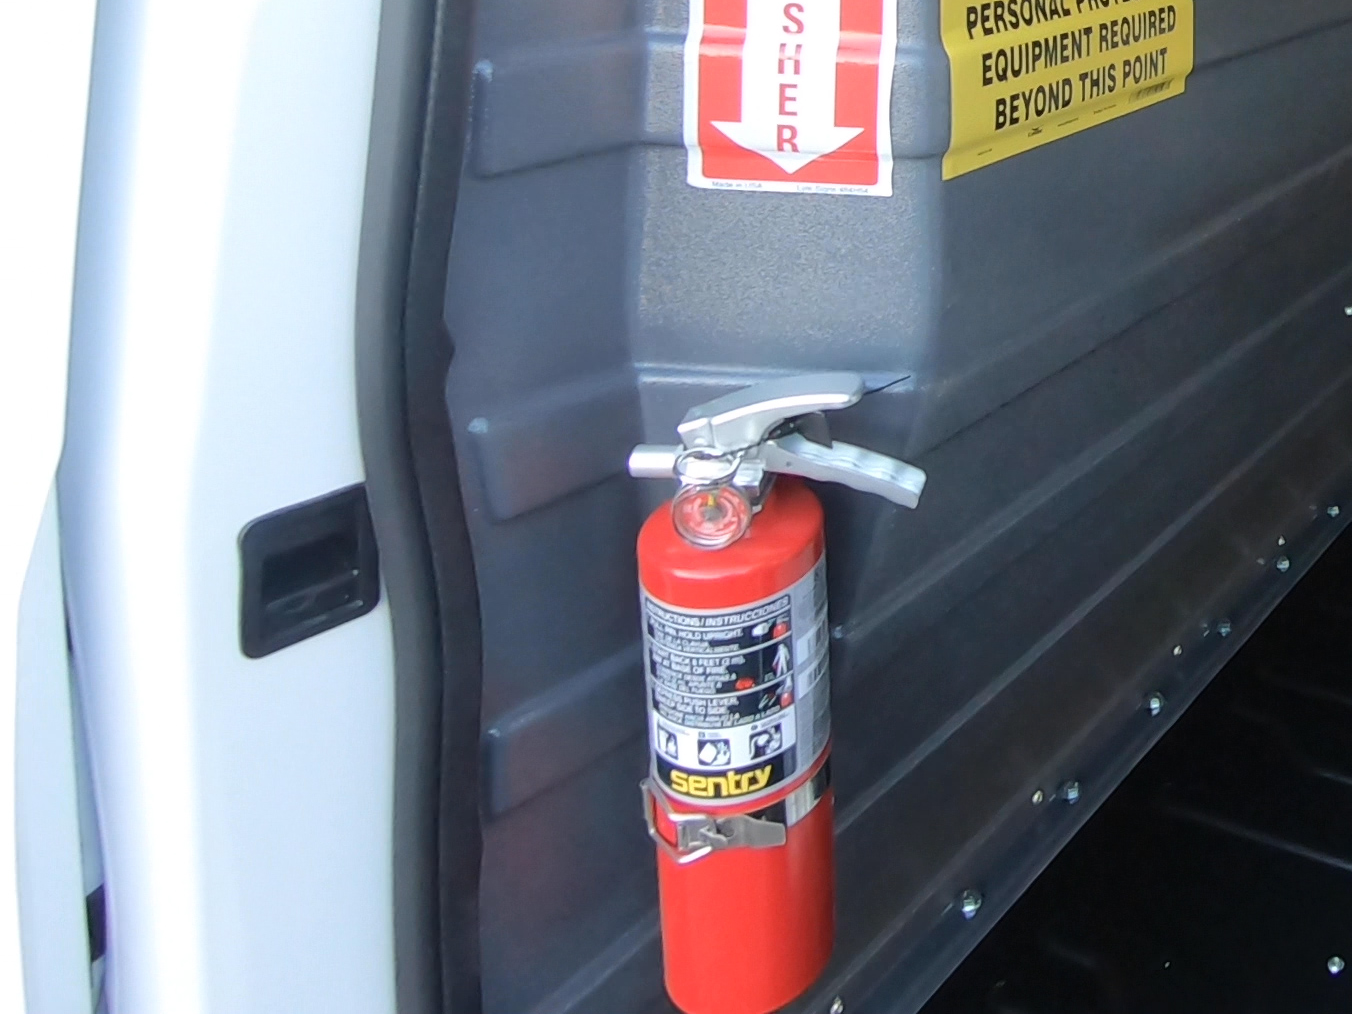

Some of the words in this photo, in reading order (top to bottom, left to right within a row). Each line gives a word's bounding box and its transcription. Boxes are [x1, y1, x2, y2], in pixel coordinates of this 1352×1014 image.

[982, 26, 1093, 87] EQUIPMENT
[1099, 4, 1176, 53] REQUIRED
[995, 80, 1073, 131] BEYOND
[1079, 63, 1117, 102] THIS
[1122, 47, 1168, 88] POINT
[670, 764, 773, 798] sentry
